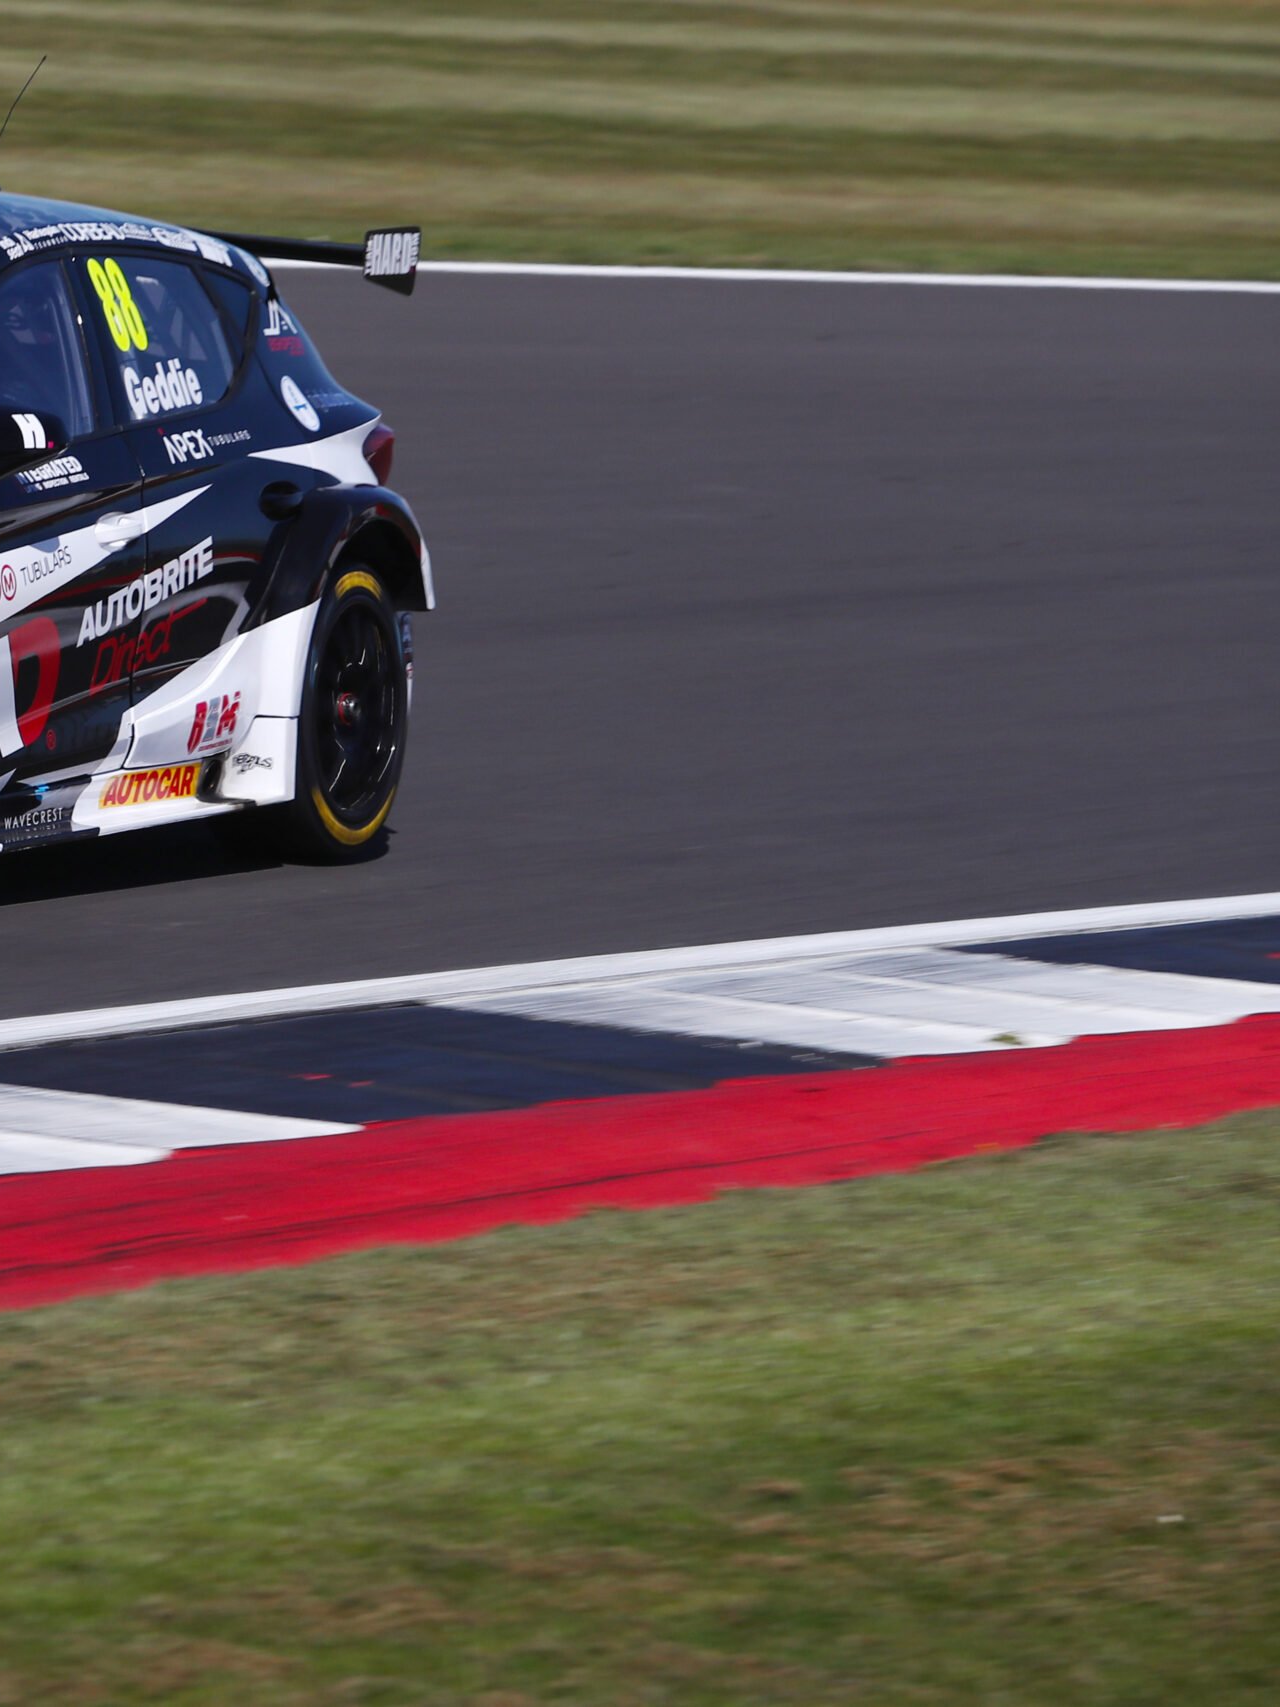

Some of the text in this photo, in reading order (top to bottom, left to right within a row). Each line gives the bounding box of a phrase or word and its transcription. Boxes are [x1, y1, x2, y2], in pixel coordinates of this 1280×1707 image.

[86, 257, 149, 352] 88
[123, 357, 203, 418] Geddie
[162, 428, 214, 465] APEX
[20, 545, 72, 587] TUBULARS
[76, 535, 214, 649] AUTOBRITE
[89, 598, 208, 697] Direct
[103, 765, 196, 807] AUTOCAR
[4, 807, 63, 830] WAVECREST
